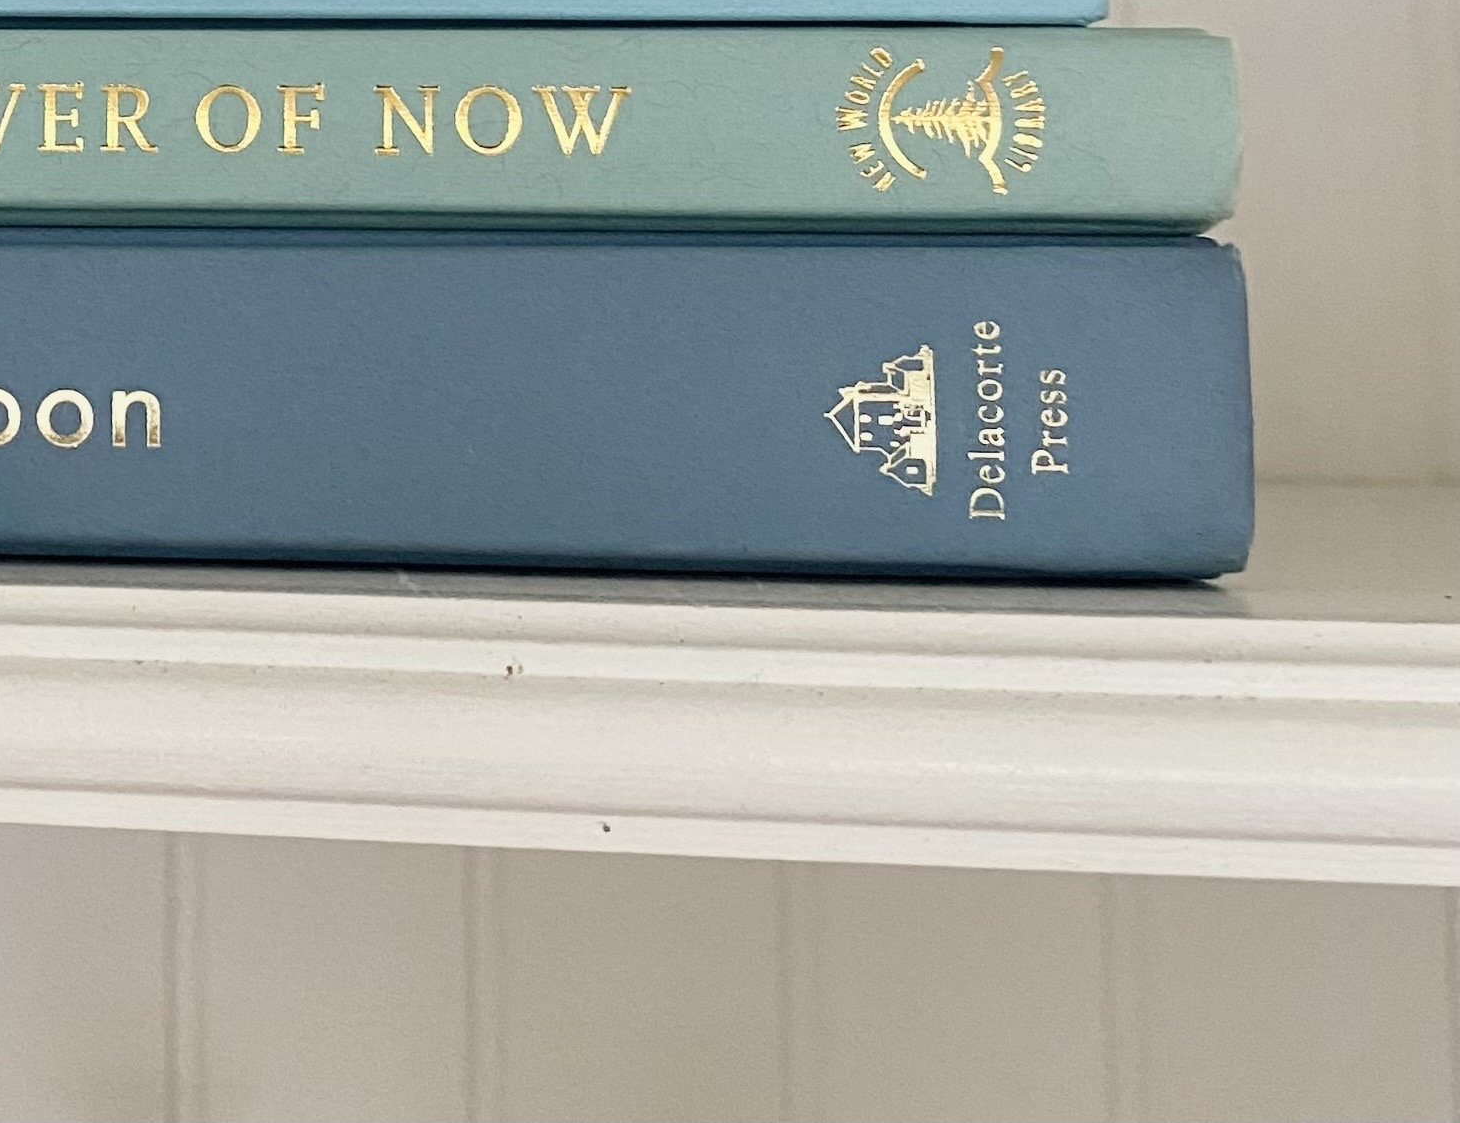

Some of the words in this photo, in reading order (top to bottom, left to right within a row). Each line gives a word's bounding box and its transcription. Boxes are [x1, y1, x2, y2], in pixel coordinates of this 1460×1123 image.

[195, 82, 326, 157] OF
[372, 83, 634, 158] NOW
[834, 46, 894, 132] WORLD
[1001, 70, 1047, 174] LIBRARY
[848, 141, 897, 193] NEW
[966, 320, 1007, 521] Delacorte
[1030, 368, 1070, 476] Press
